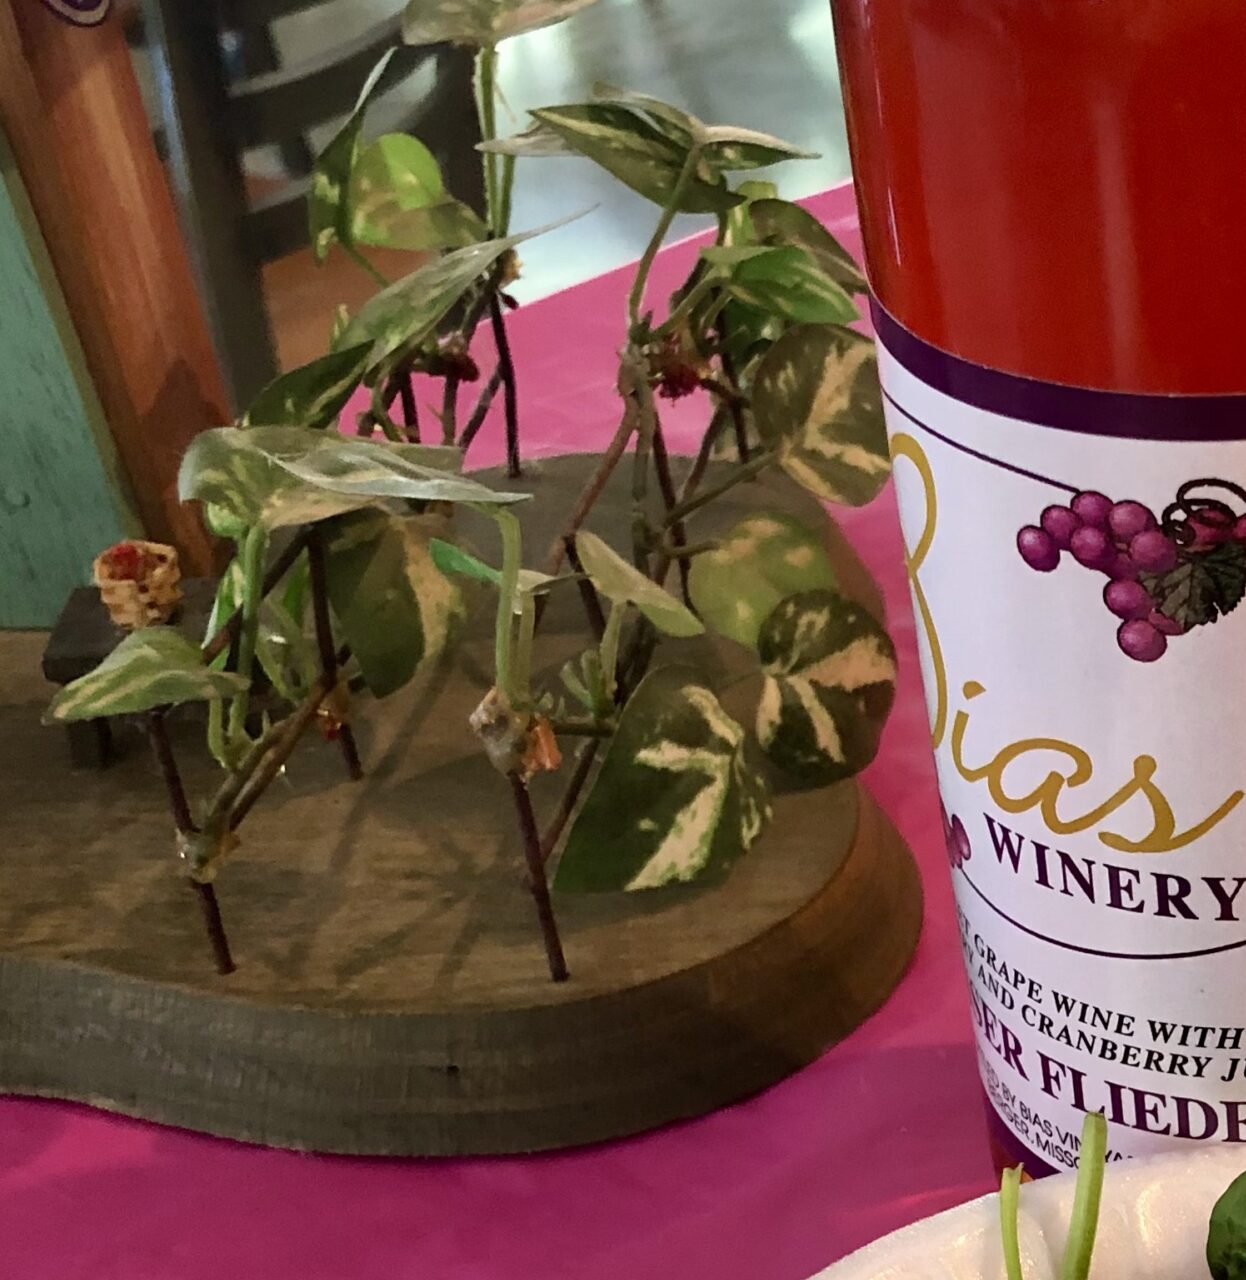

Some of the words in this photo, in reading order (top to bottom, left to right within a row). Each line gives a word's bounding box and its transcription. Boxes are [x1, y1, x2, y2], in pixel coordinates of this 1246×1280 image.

[974, 933, 1043, 1004] GRAPE
[1051, 990, 1135, 1037] WINE
[1147, 1019, 1245, 1049] WITH
[977, 964, 1016, 1011] AND
[1021, 1004, 1213, 1078] CRANBERRY
[1001, 1082, 1016, 1107] BY
[1019, 1100, 1053, 1137] BIAS
